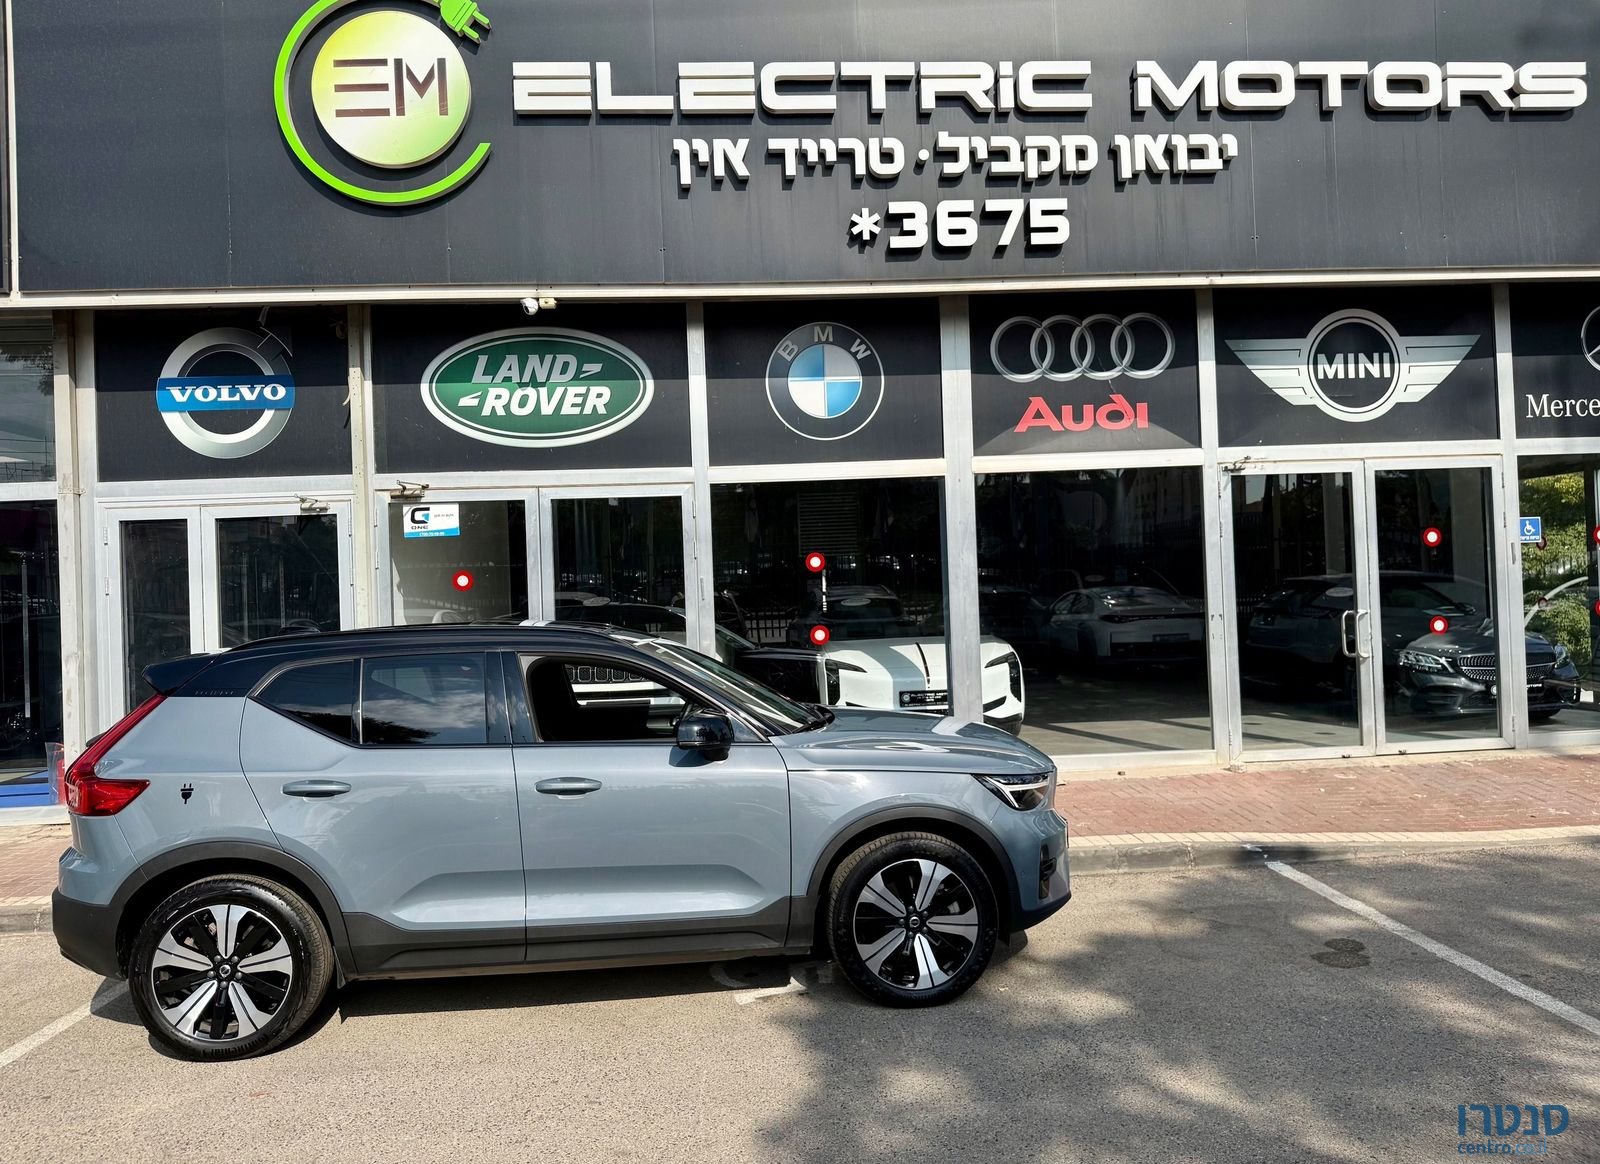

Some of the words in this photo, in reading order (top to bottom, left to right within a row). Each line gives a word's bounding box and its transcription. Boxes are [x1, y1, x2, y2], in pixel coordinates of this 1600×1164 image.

[333, 57, 449, 117] EM
[512, 60, 1093, 115] ELECTRIC
[1135, 60, 1588, 112] MOTORS
[672, 137, 751, 190] אין
[767, 137, 905, 181] טרייד
[937, 130, 1099, 180] מקביל
[1111, 133, 1239, 182] יבואן
[777, 325, 872, 362] BMW
[472, 353, 577, 384] LAND
[1316, 351, 1392, 381] MINI
[165, 382, 287, 402] VOLVO
[481, 385, 613, 417] ROVER
[1013, 393, 1149, 433] Audi
